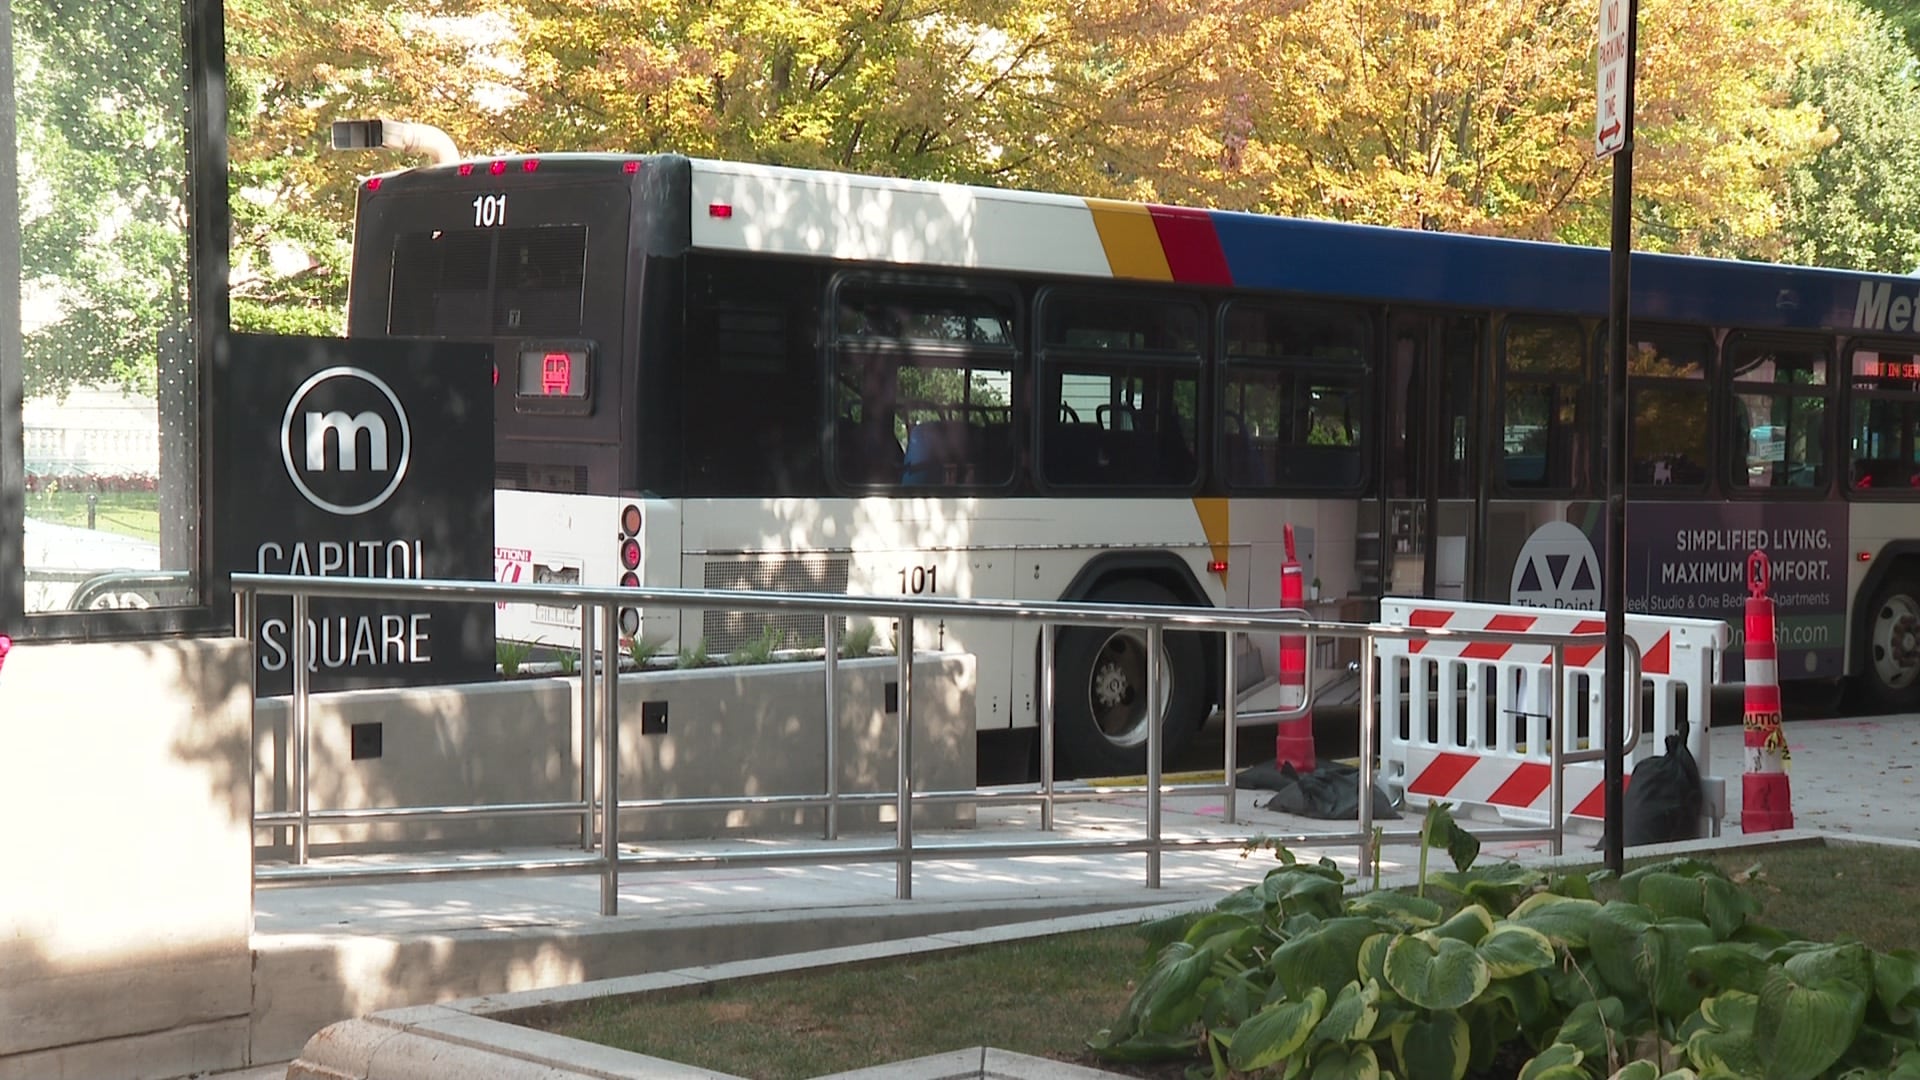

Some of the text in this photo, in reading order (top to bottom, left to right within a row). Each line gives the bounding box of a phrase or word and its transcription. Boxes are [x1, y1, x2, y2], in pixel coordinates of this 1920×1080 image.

[1607, 1, 1619, 35] NO
[1600, 32, 1625, 69] PARKING
[473, 194, 506, 227] 101
[1864, 361, 1885, 377] NOT
[1888, 362, 1901, 378] IN
[1676, 529, 1831, 551] SIMPLIFIED LIVING.
[898, 565, 937, 595] 101
[1661, 562, 1744, 583] MAXIMUM
[1626, 595, 1649, 612] eek
[1650, 594, 1685, 611] Studio
[1687, 594, 1695, 609] &
[1698, 593, 1720, 609] One
[1773, 592, 1830, 608] Apartments
[1727, 621, 1829, 647] Onsh.com
